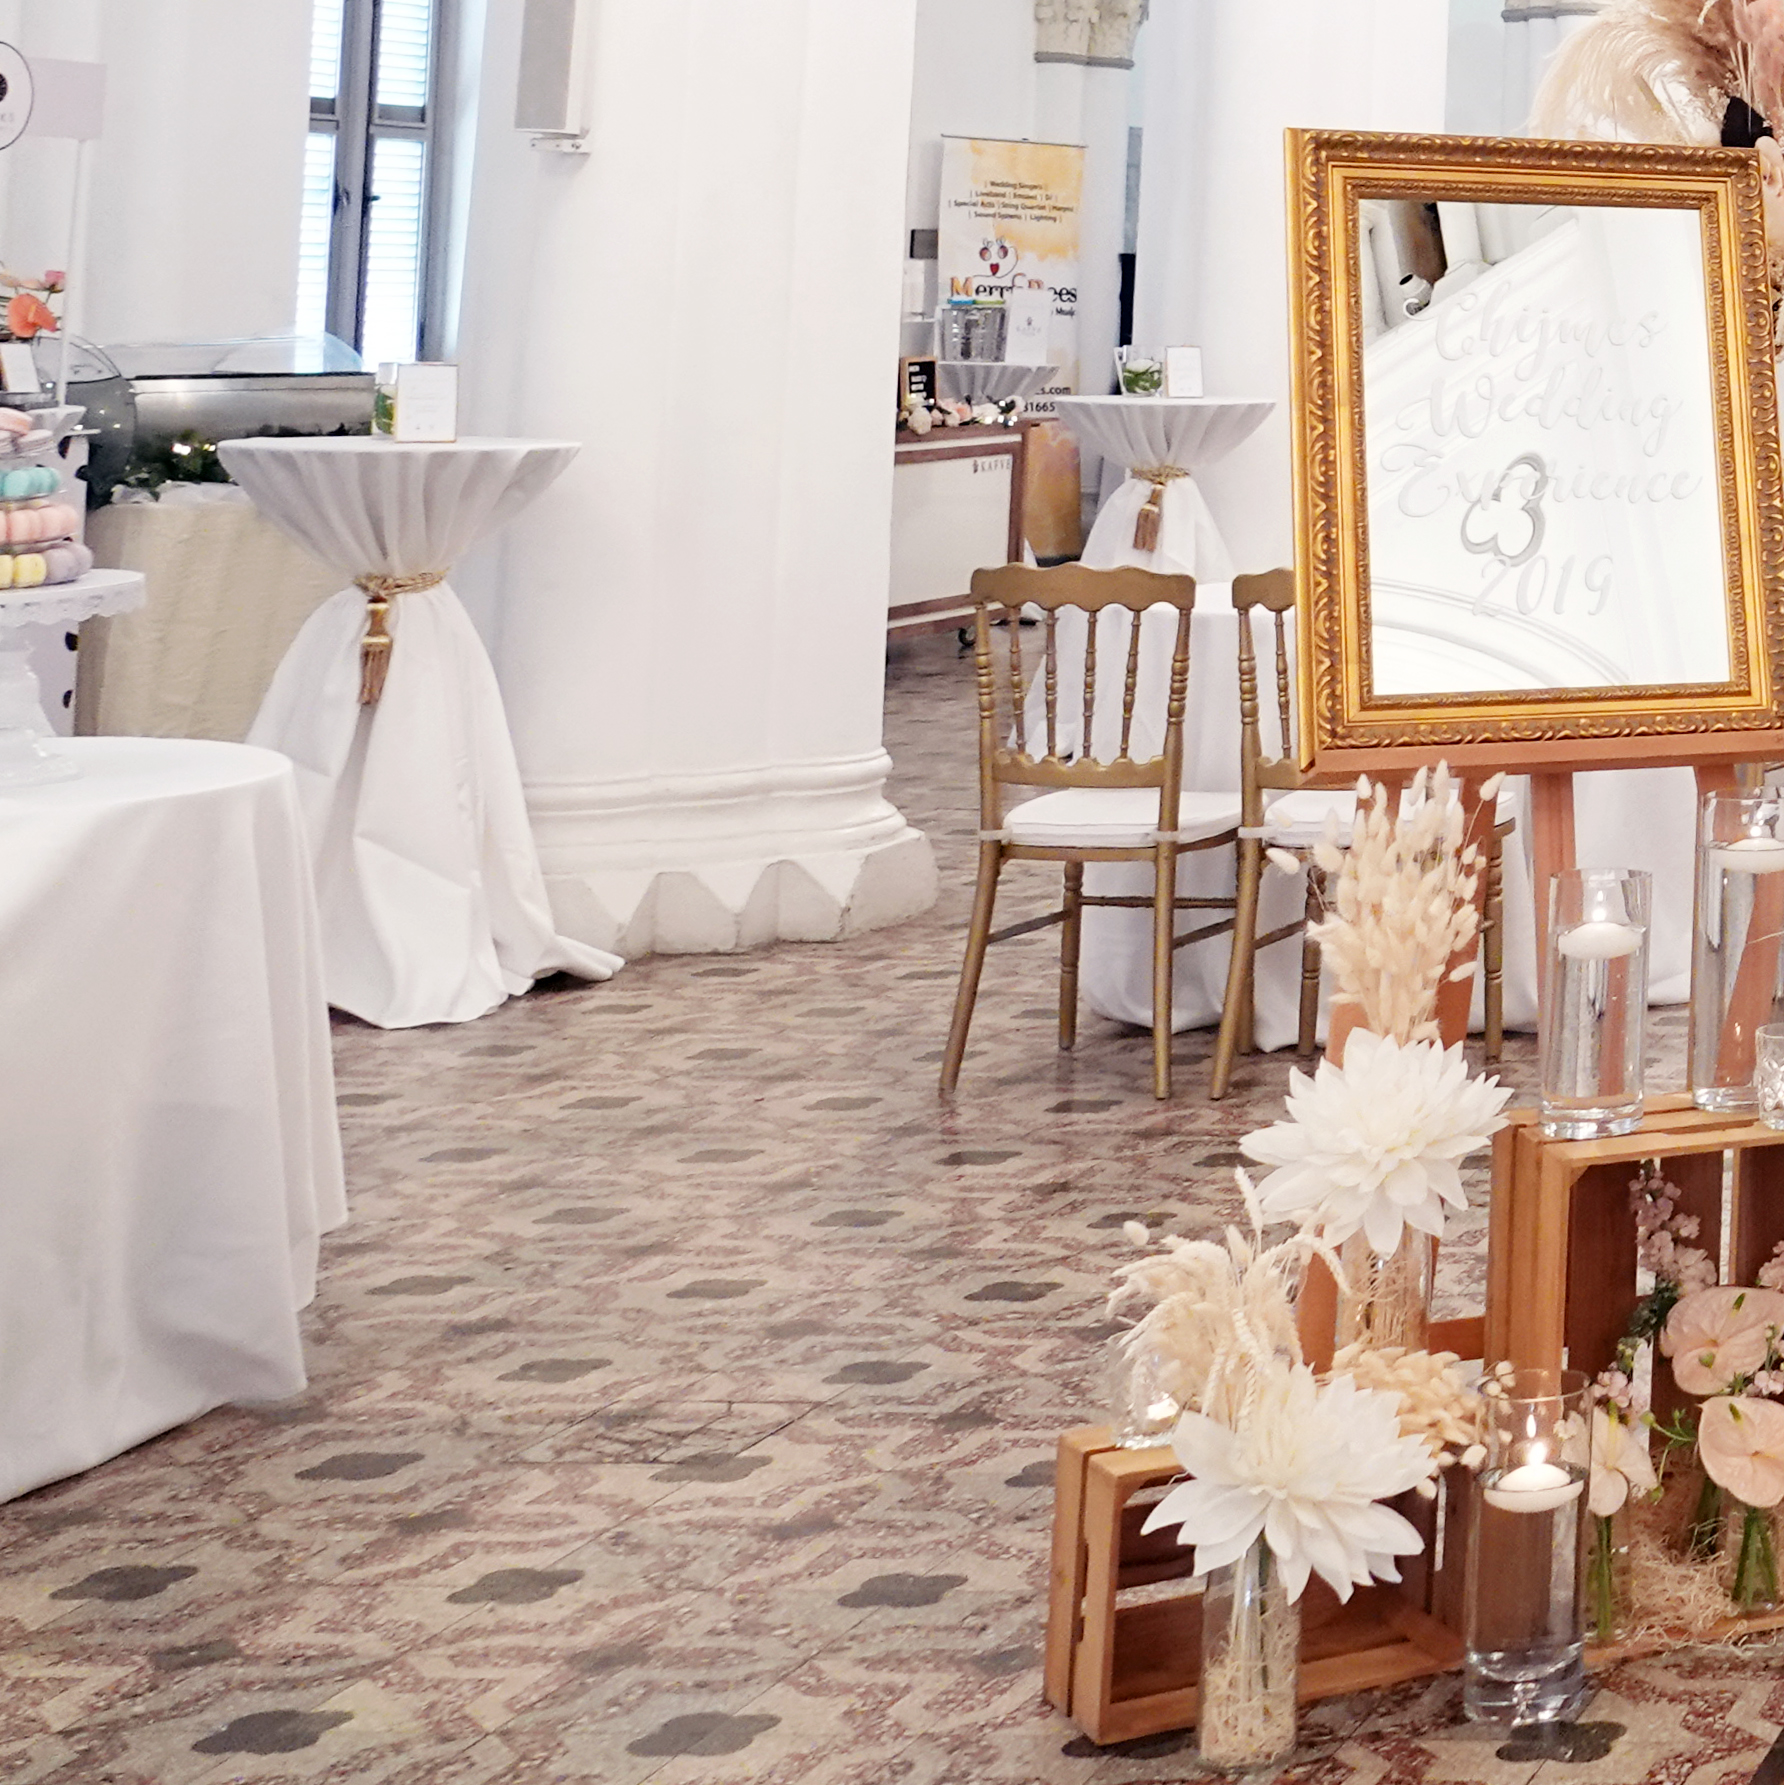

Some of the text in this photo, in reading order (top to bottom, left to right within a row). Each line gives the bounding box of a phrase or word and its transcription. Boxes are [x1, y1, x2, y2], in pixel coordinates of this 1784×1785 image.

[1403, 280, 1668, 381] Chijmes
[1396, 365, 1684, 457] Wedding
[1380, 444, 1704, 517] Experience
[1472, 554, 1615, 617] 2019
